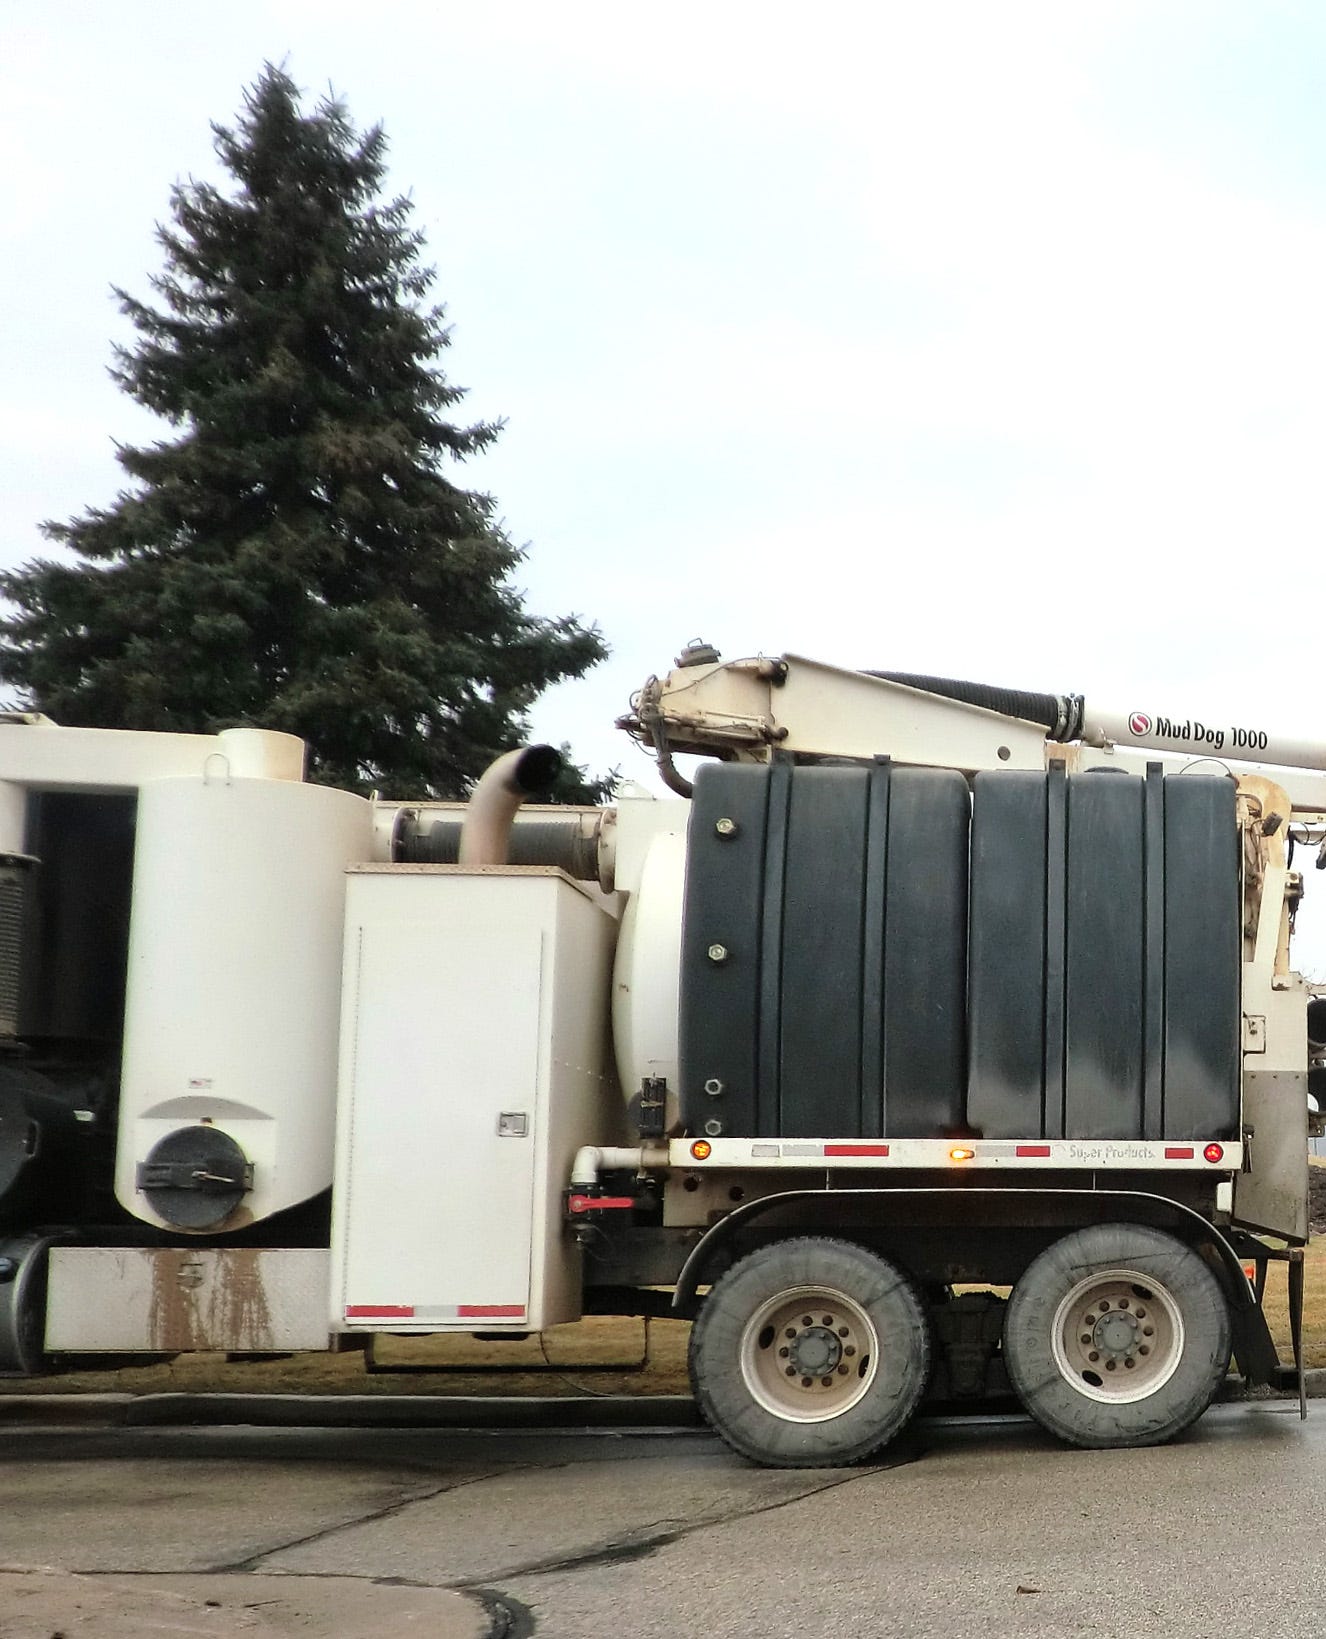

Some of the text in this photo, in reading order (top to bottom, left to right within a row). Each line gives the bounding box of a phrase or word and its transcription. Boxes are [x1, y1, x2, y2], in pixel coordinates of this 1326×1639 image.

[1156, 716, 1268, 750] Mud Dog 1000
